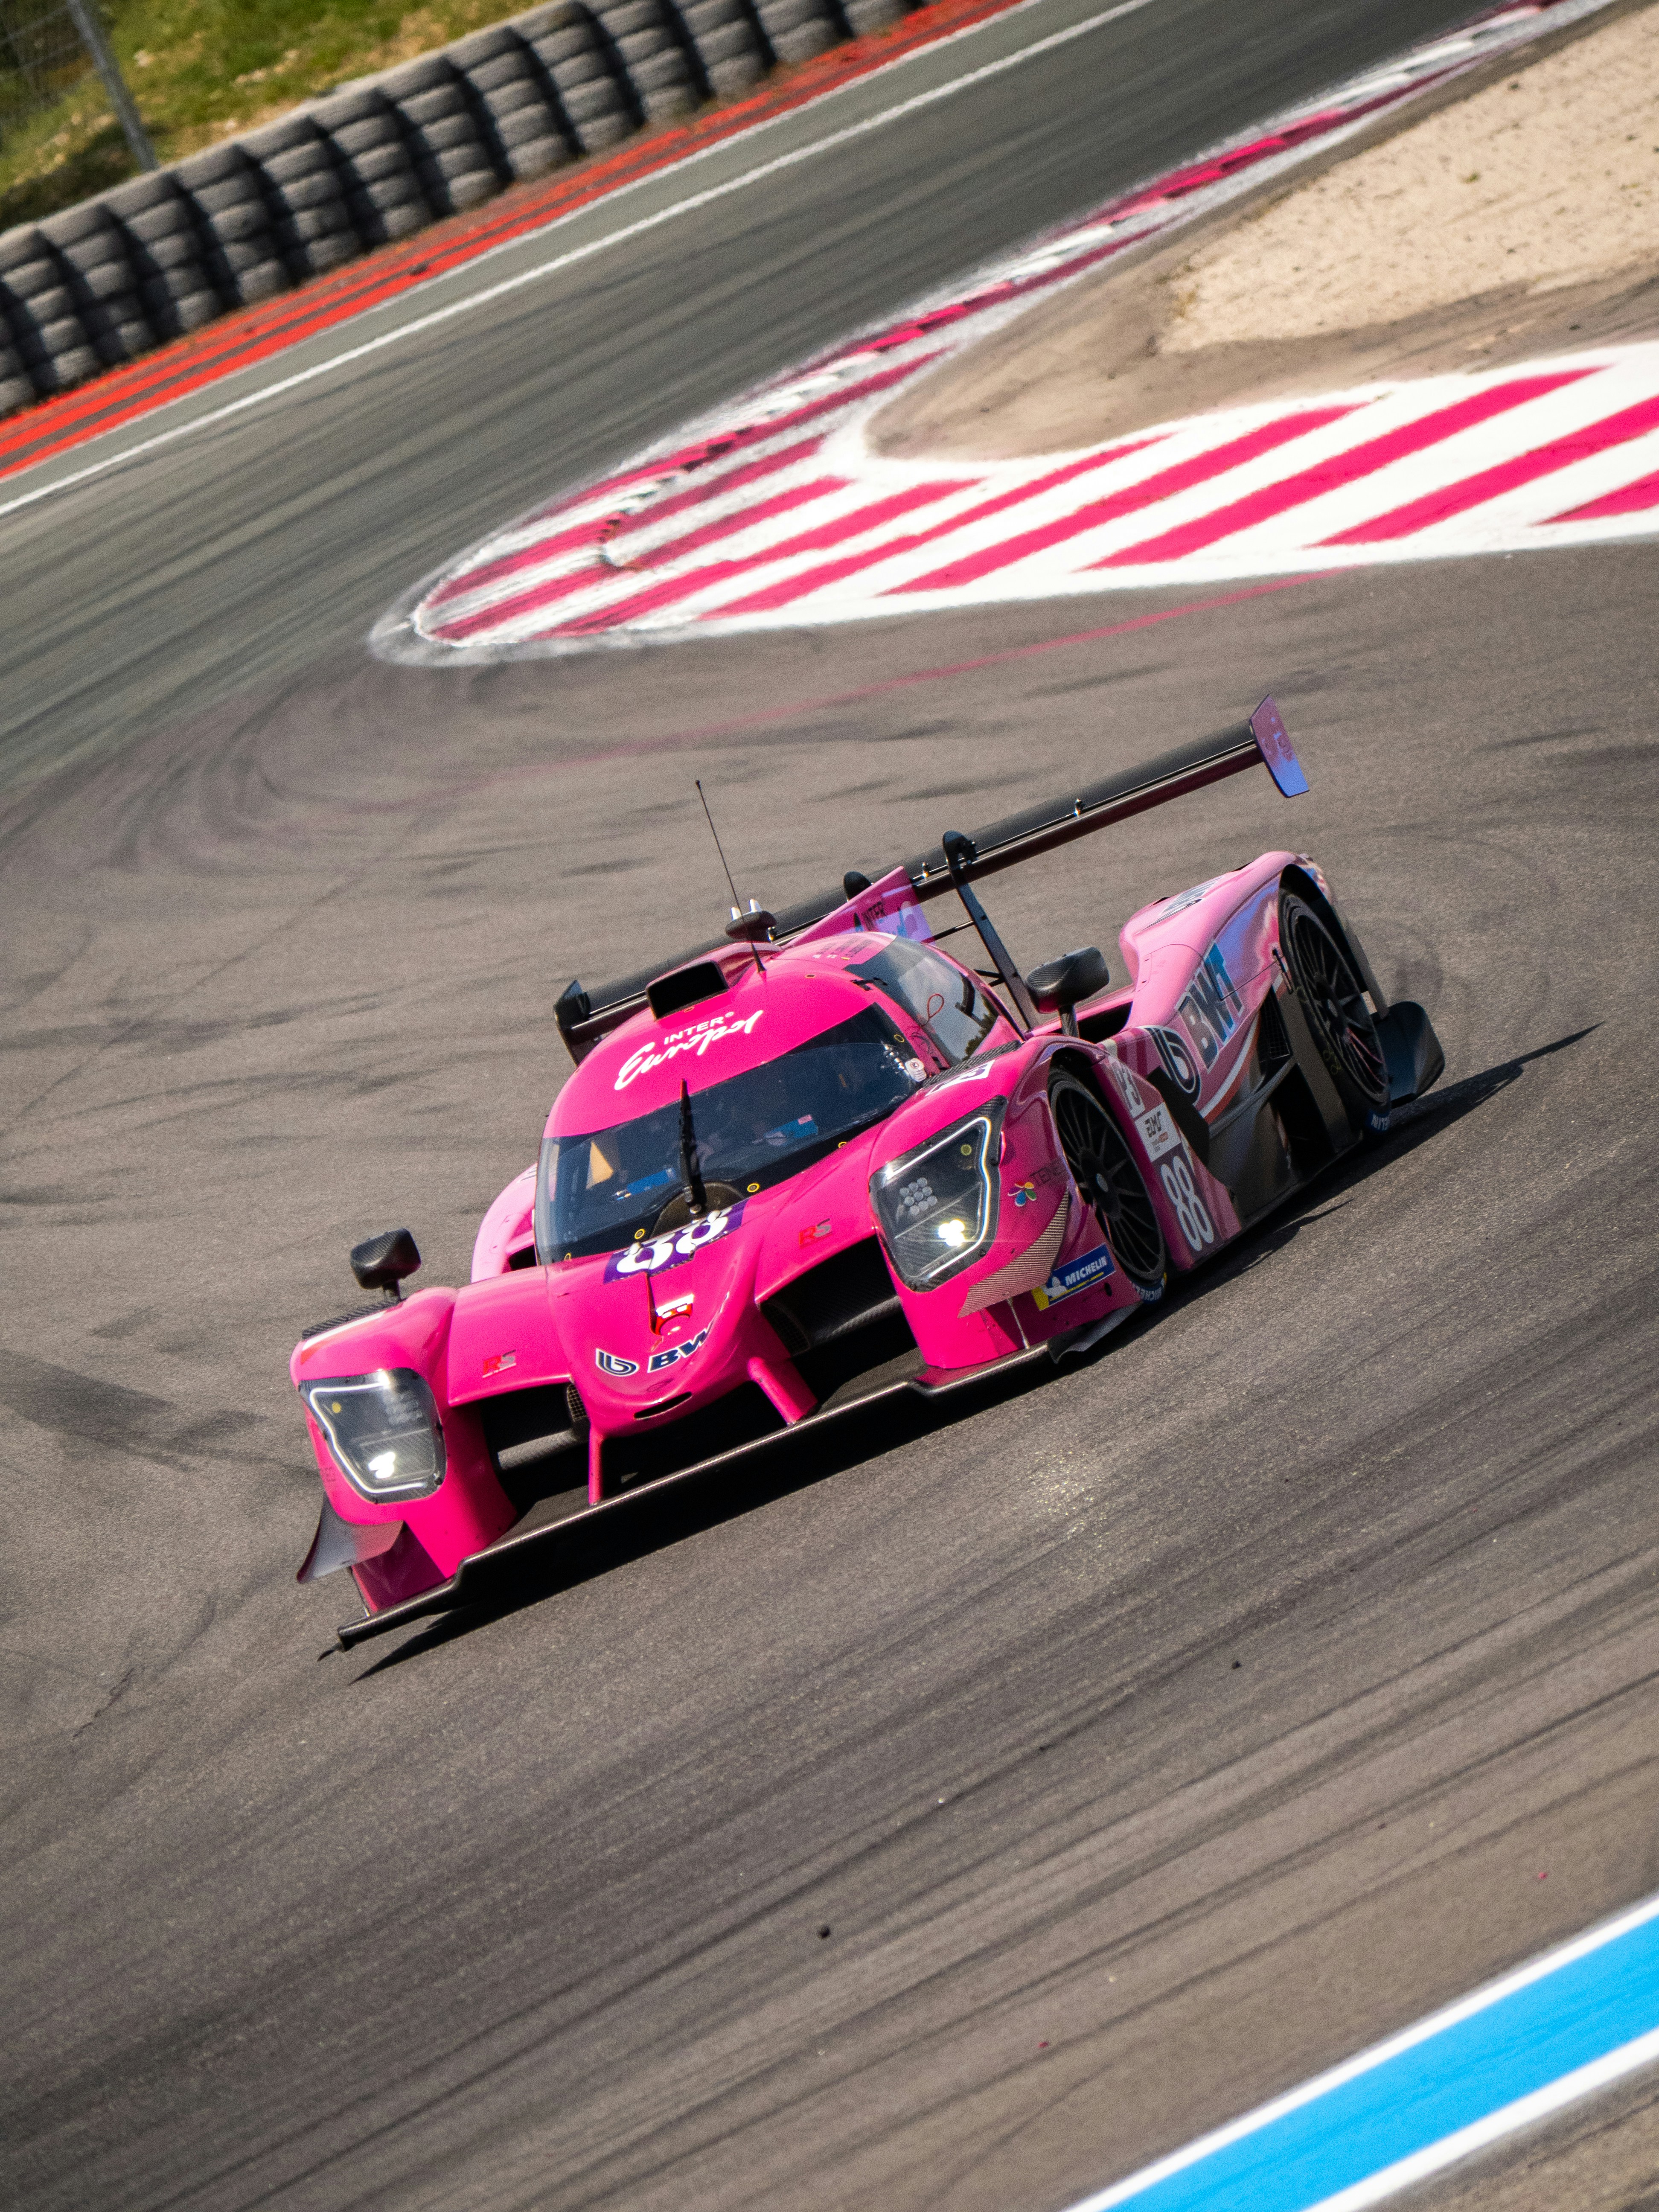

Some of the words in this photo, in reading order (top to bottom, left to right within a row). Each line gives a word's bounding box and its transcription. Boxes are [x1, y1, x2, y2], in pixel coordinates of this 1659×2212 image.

[1174, 940, 1245, 1074] BWT
[614, 1010, 764, 1090] Europol
[1160, 1155, 1214, 1251] 88
[798, 1218, 831, 1246] RS
[1065, 1256, 1108, 1286] MICHELIN
[483, 1349, 516, 1374] RS
